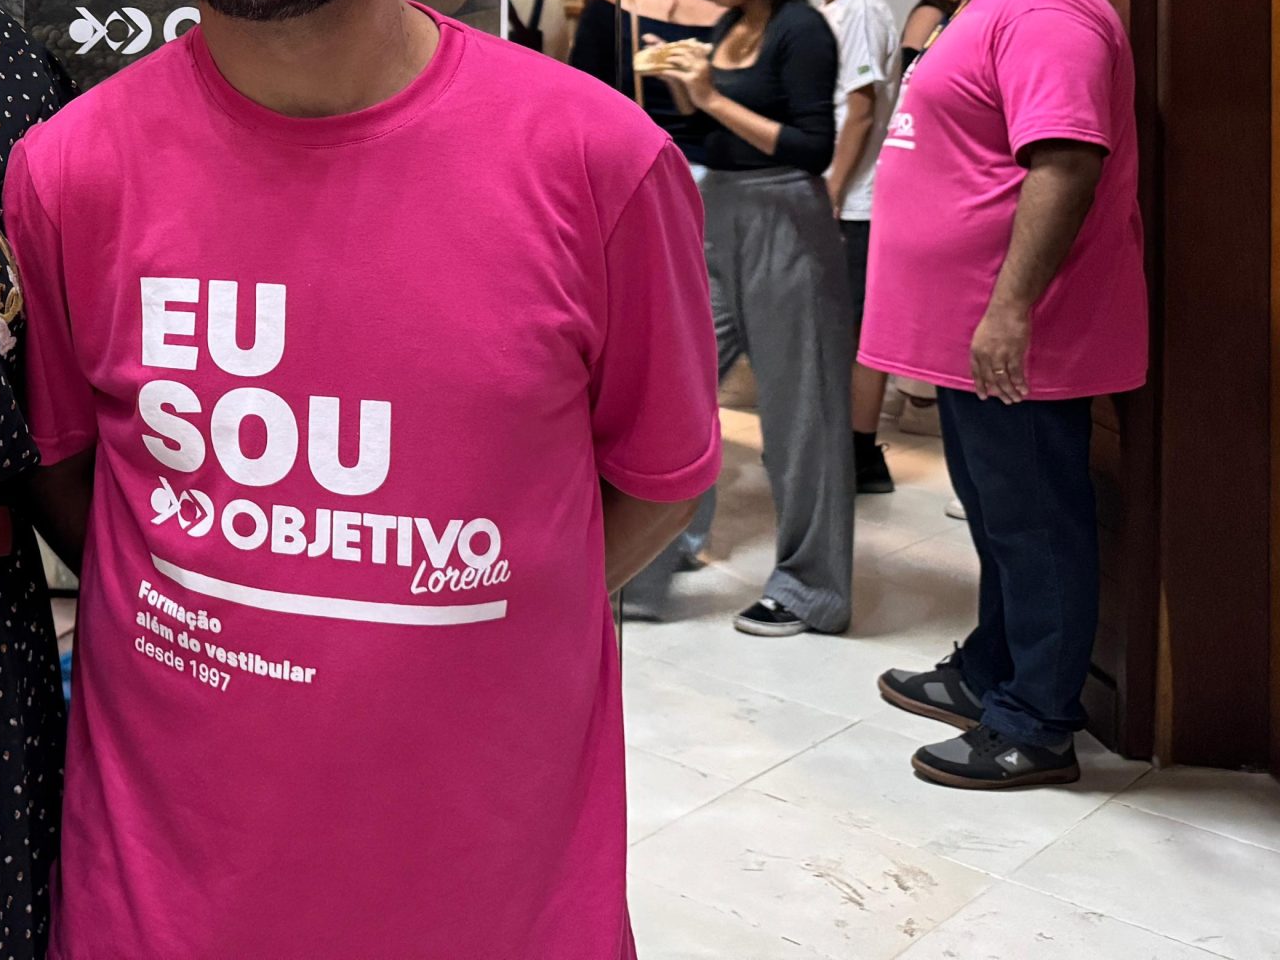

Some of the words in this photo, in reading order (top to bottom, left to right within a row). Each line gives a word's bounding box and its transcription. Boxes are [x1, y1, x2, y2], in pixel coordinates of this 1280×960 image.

[140, 277, 287, 377] EU
[138, 379, 392, 497] SOU
[221, 499, 501, 569] OBJETIVO
[138, 579, 222, 634] Formação
[410, 558, 511, 595] Lorena
[134, 636, 185, 673] desde
[189, 659, 231, 691] 1997
[136, 610, 174, 645] além
[178, 631, 201, 653] do
[205, 644, 316, 684] vestibular
